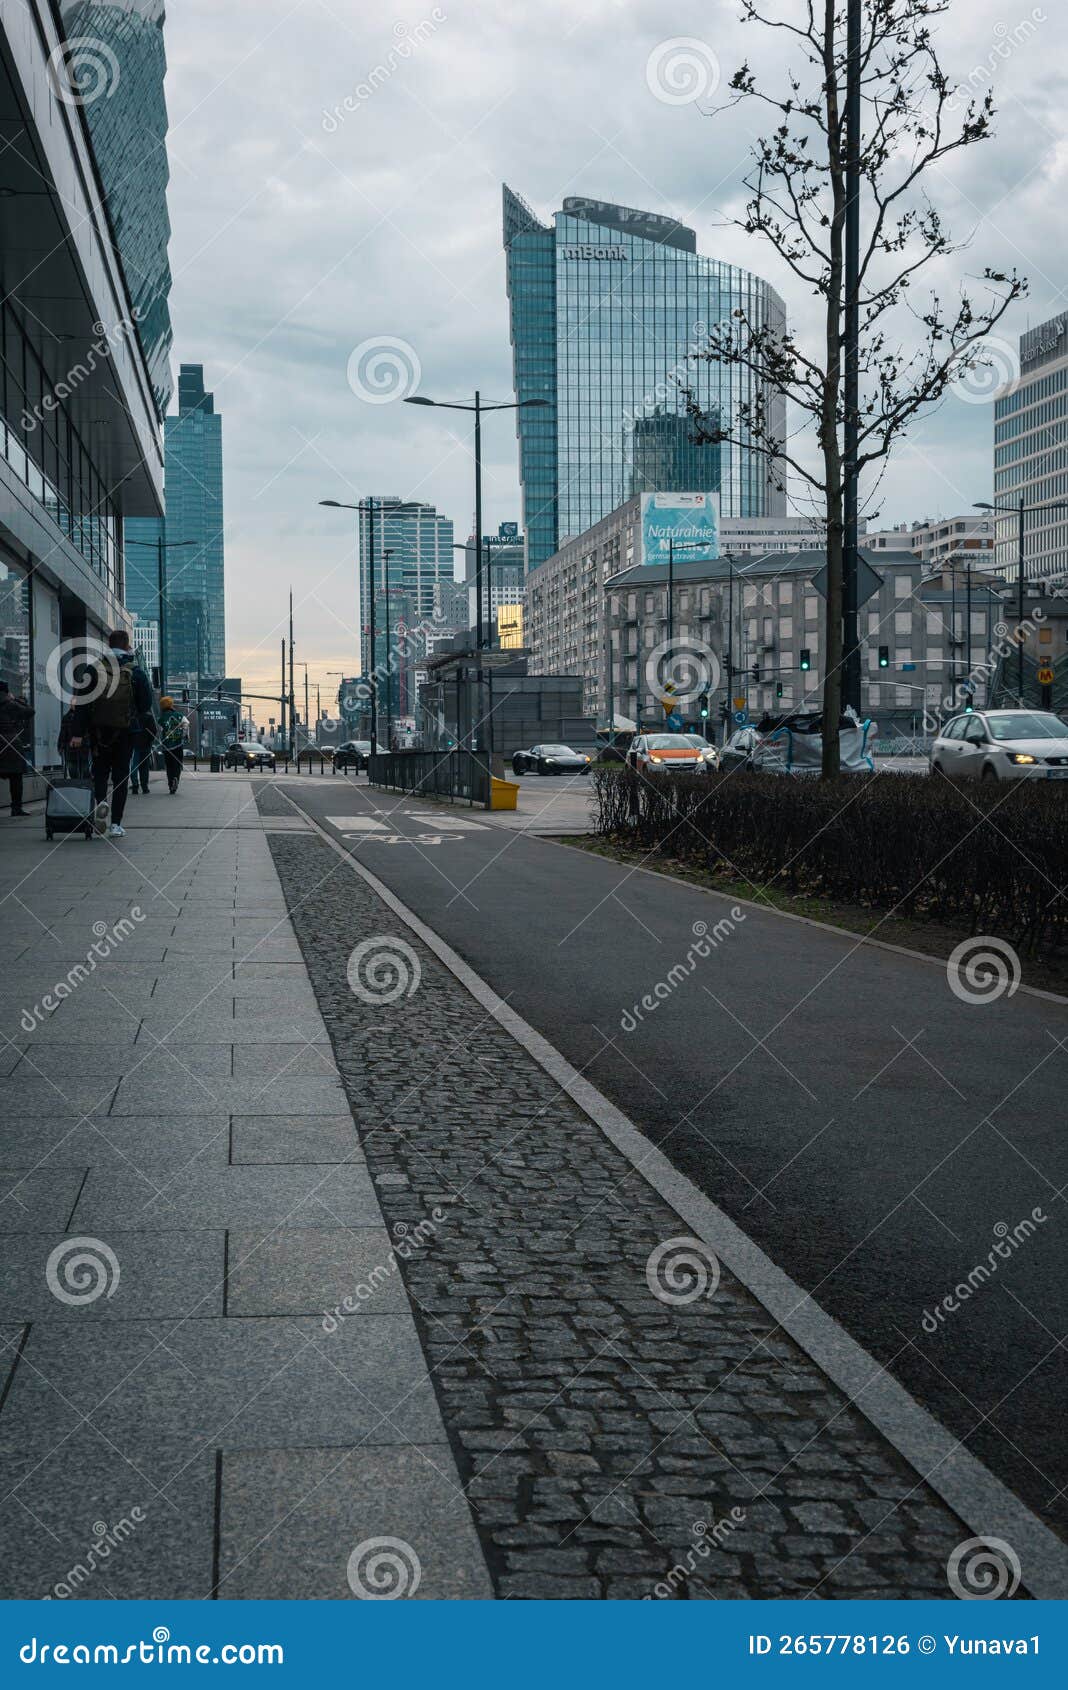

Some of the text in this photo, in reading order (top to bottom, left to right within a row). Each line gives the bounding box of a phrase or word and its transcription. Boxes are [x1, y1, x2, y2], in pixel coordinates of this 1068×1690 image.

[562, 246, 628, 260] mBank
[647, 525, 713, 537] Naturalnie
[1040, 670, 1052, 681] M
